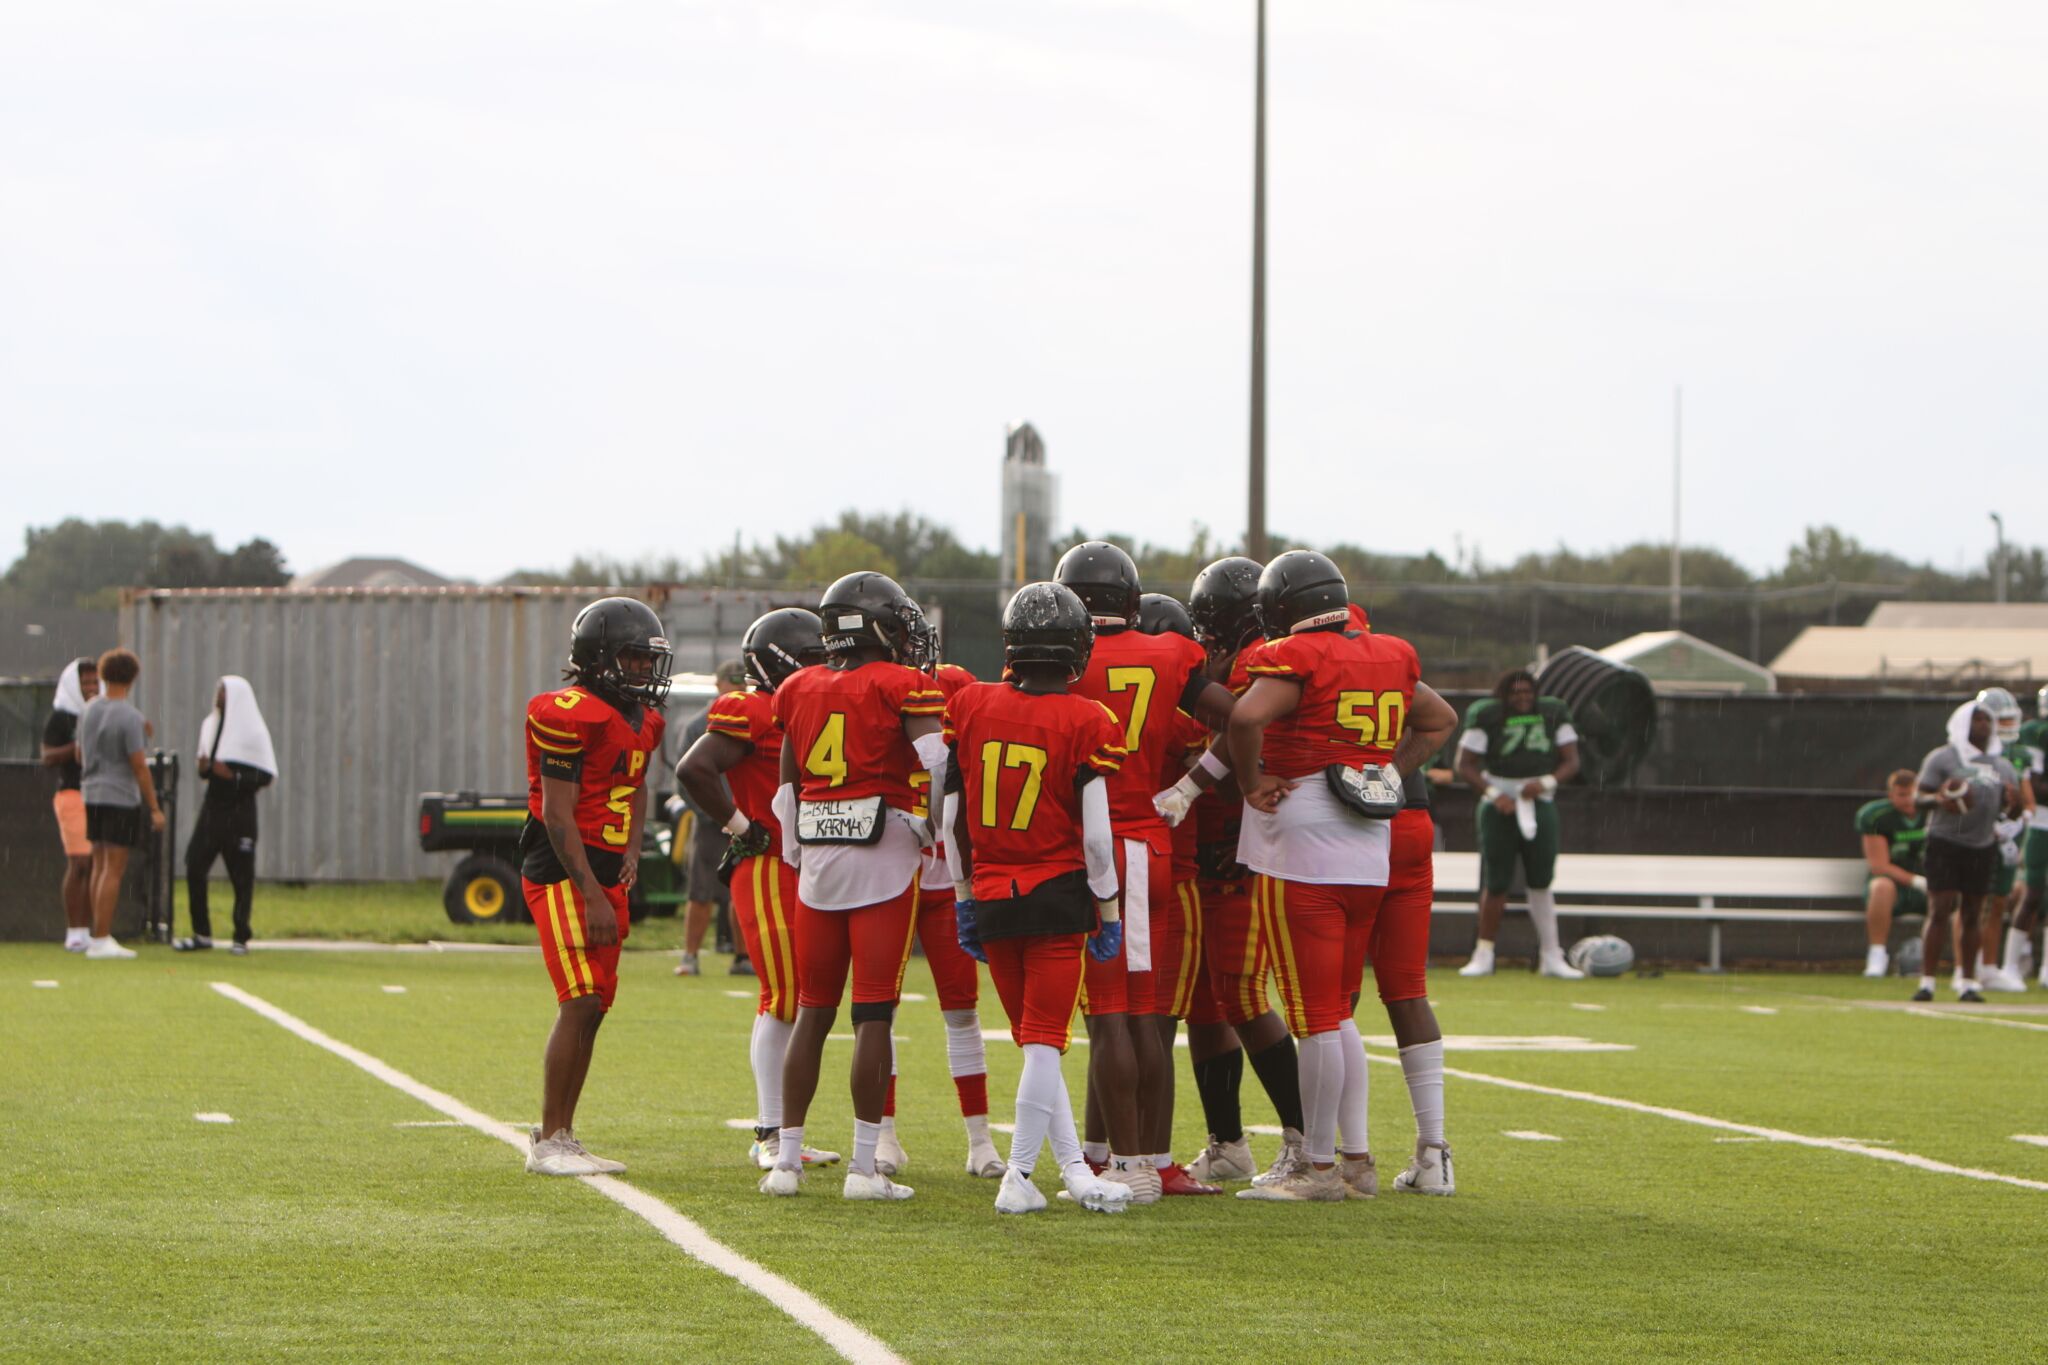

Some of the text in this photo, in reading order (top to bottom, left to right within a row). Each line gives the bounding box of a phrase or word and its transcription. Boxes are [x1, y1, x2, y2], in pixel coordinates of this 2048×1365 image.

[1313, 612, 1345, 626] Riddell
[554, 690, 587, 709] 5
[1107, 666, 1157, 752] 7
[1329, 690, 1406, 749] 50
[805, 711, 848, 788] 4
[1501, 723, 1551, 756] 74
[602, 785, 637, 846] 5
[980, 740, 1048, 832] 17
[816, 816, 862, 838] KARMA
